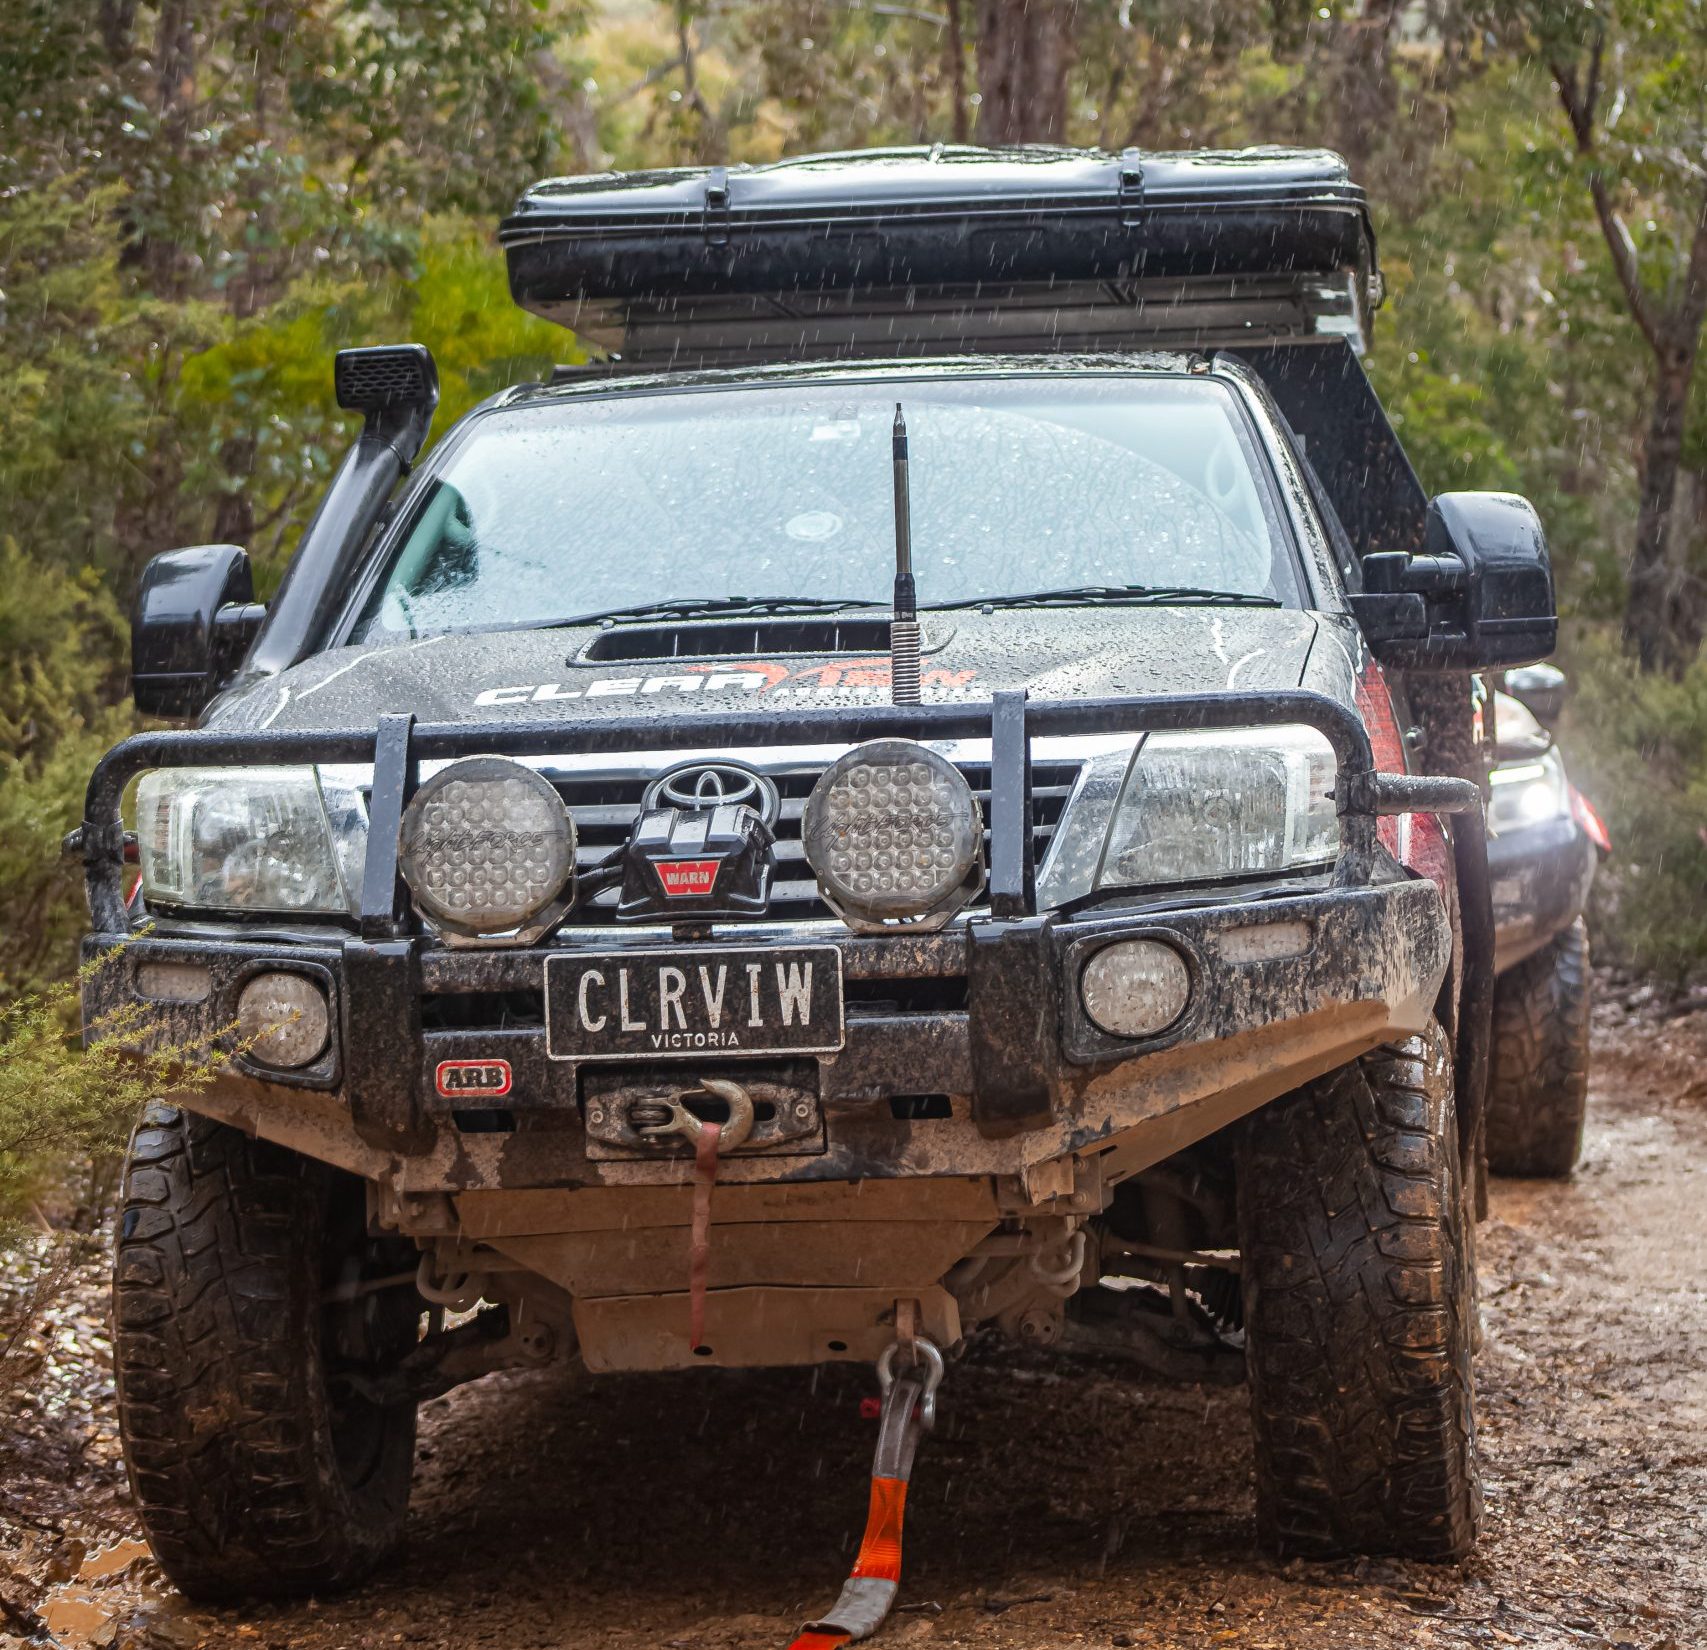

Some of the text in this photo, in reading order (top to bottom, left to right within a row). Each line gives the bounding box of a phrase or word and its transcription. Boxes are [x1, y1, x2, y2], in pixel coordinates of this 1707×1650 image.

[666, 871, 710, 885] WARN
[578, 961, 813, 1033] CLRVIW
[651, 1032, 740, 1049] VICTORIA
[444, 1067, 504, 1089] ARB
